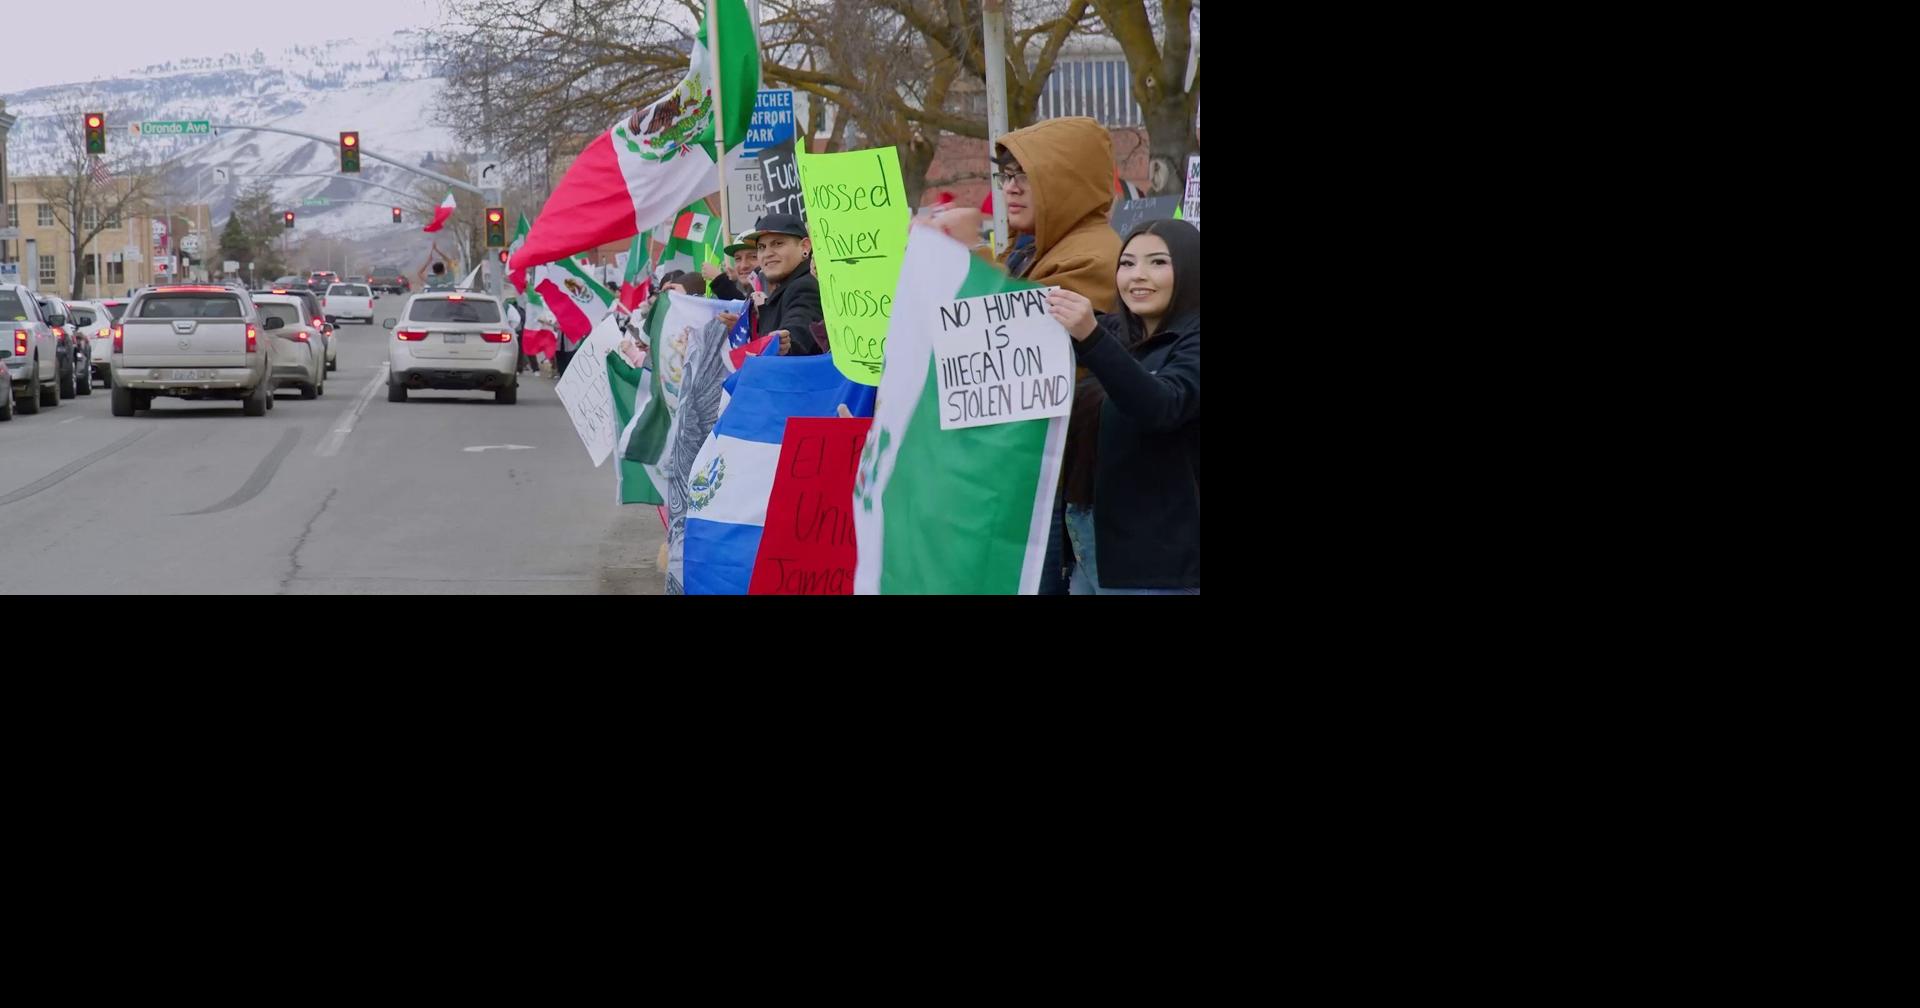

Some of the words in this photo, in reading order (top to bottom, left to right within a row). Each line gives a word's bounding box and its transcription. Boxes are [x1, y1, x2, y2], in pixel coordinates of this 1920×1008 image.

[751, 110, 792, 126] RFRONT
[755, 93, 790, 108] TCHEE
[143, 122, 182, 134] Orondo
[186, 121, 208, 133] Ave
[746, 128, 775, 143] PARK
[745, 183, 764, 193] RIG
[802, 154, 892, 213] Crossed
[819, 217, 881, 257] River
[830, 273, 892, 318] Crosse
[940, 300, 971, 332] NO
[984, 288, 1054, 323] HUMAN
[844, 325, 887, 360] Oce
[985, 324, 1010, 351] IS
[1013, 345, 1043, 378] ON
[947, 383, 1013, 423] STOLEN
[1021, 375, 1069, 411] LAND
[790, 435, 828, 480] El
[794, 491, 857, 547] Uni
